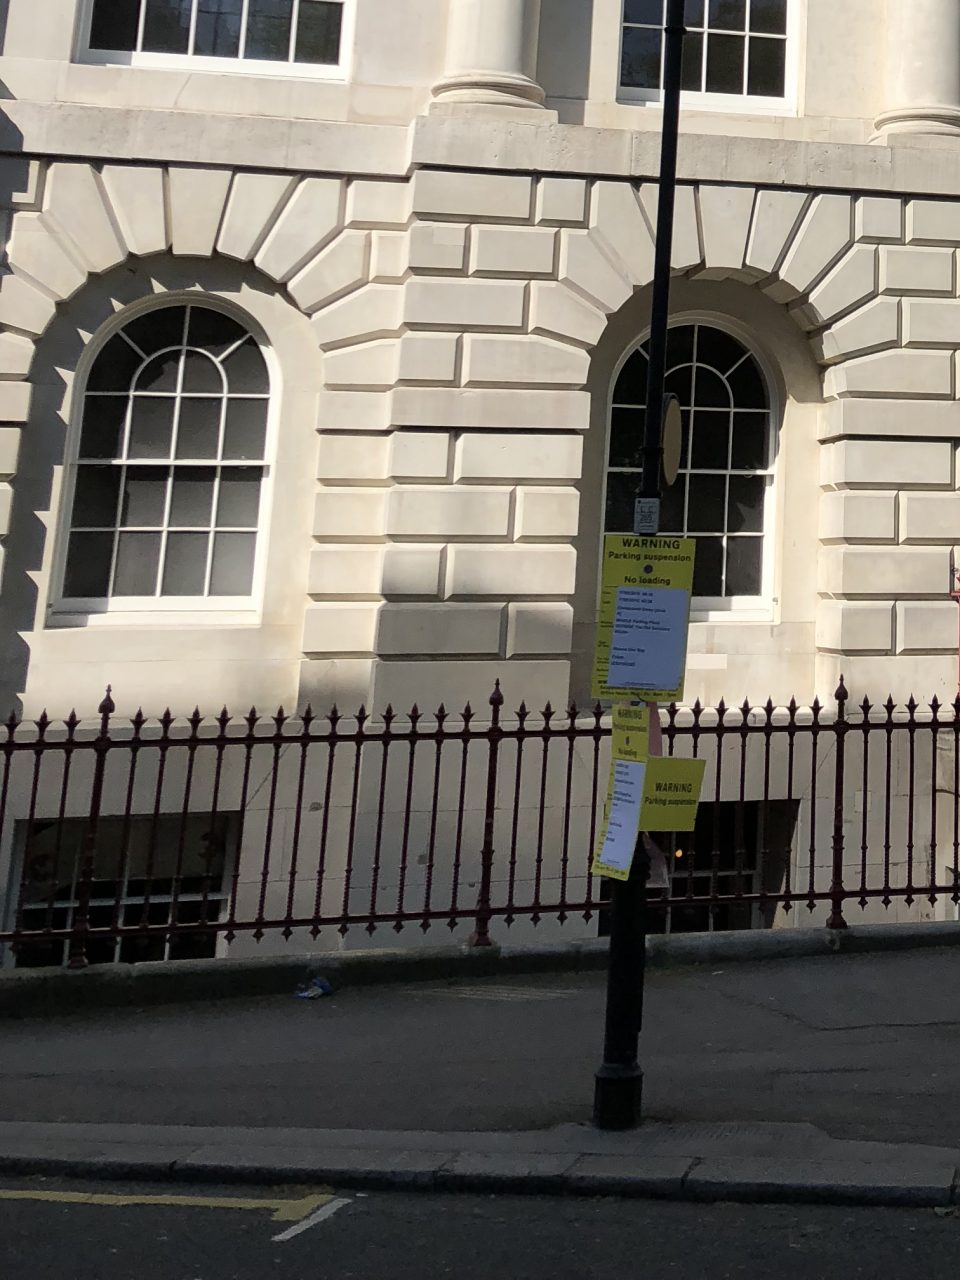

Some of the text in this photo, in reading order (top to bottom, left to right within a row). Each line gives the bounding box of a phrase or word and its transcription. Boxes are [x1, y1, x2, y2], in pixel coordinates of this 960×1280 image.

[622, 538, 680, 550] WARNING
[608, 551, 692, 562] Parking suspension
[624, 575, 671, 586] No loading
[655, 782, 692, 793] WARNING
[644, 796, 667, 806] Parking
